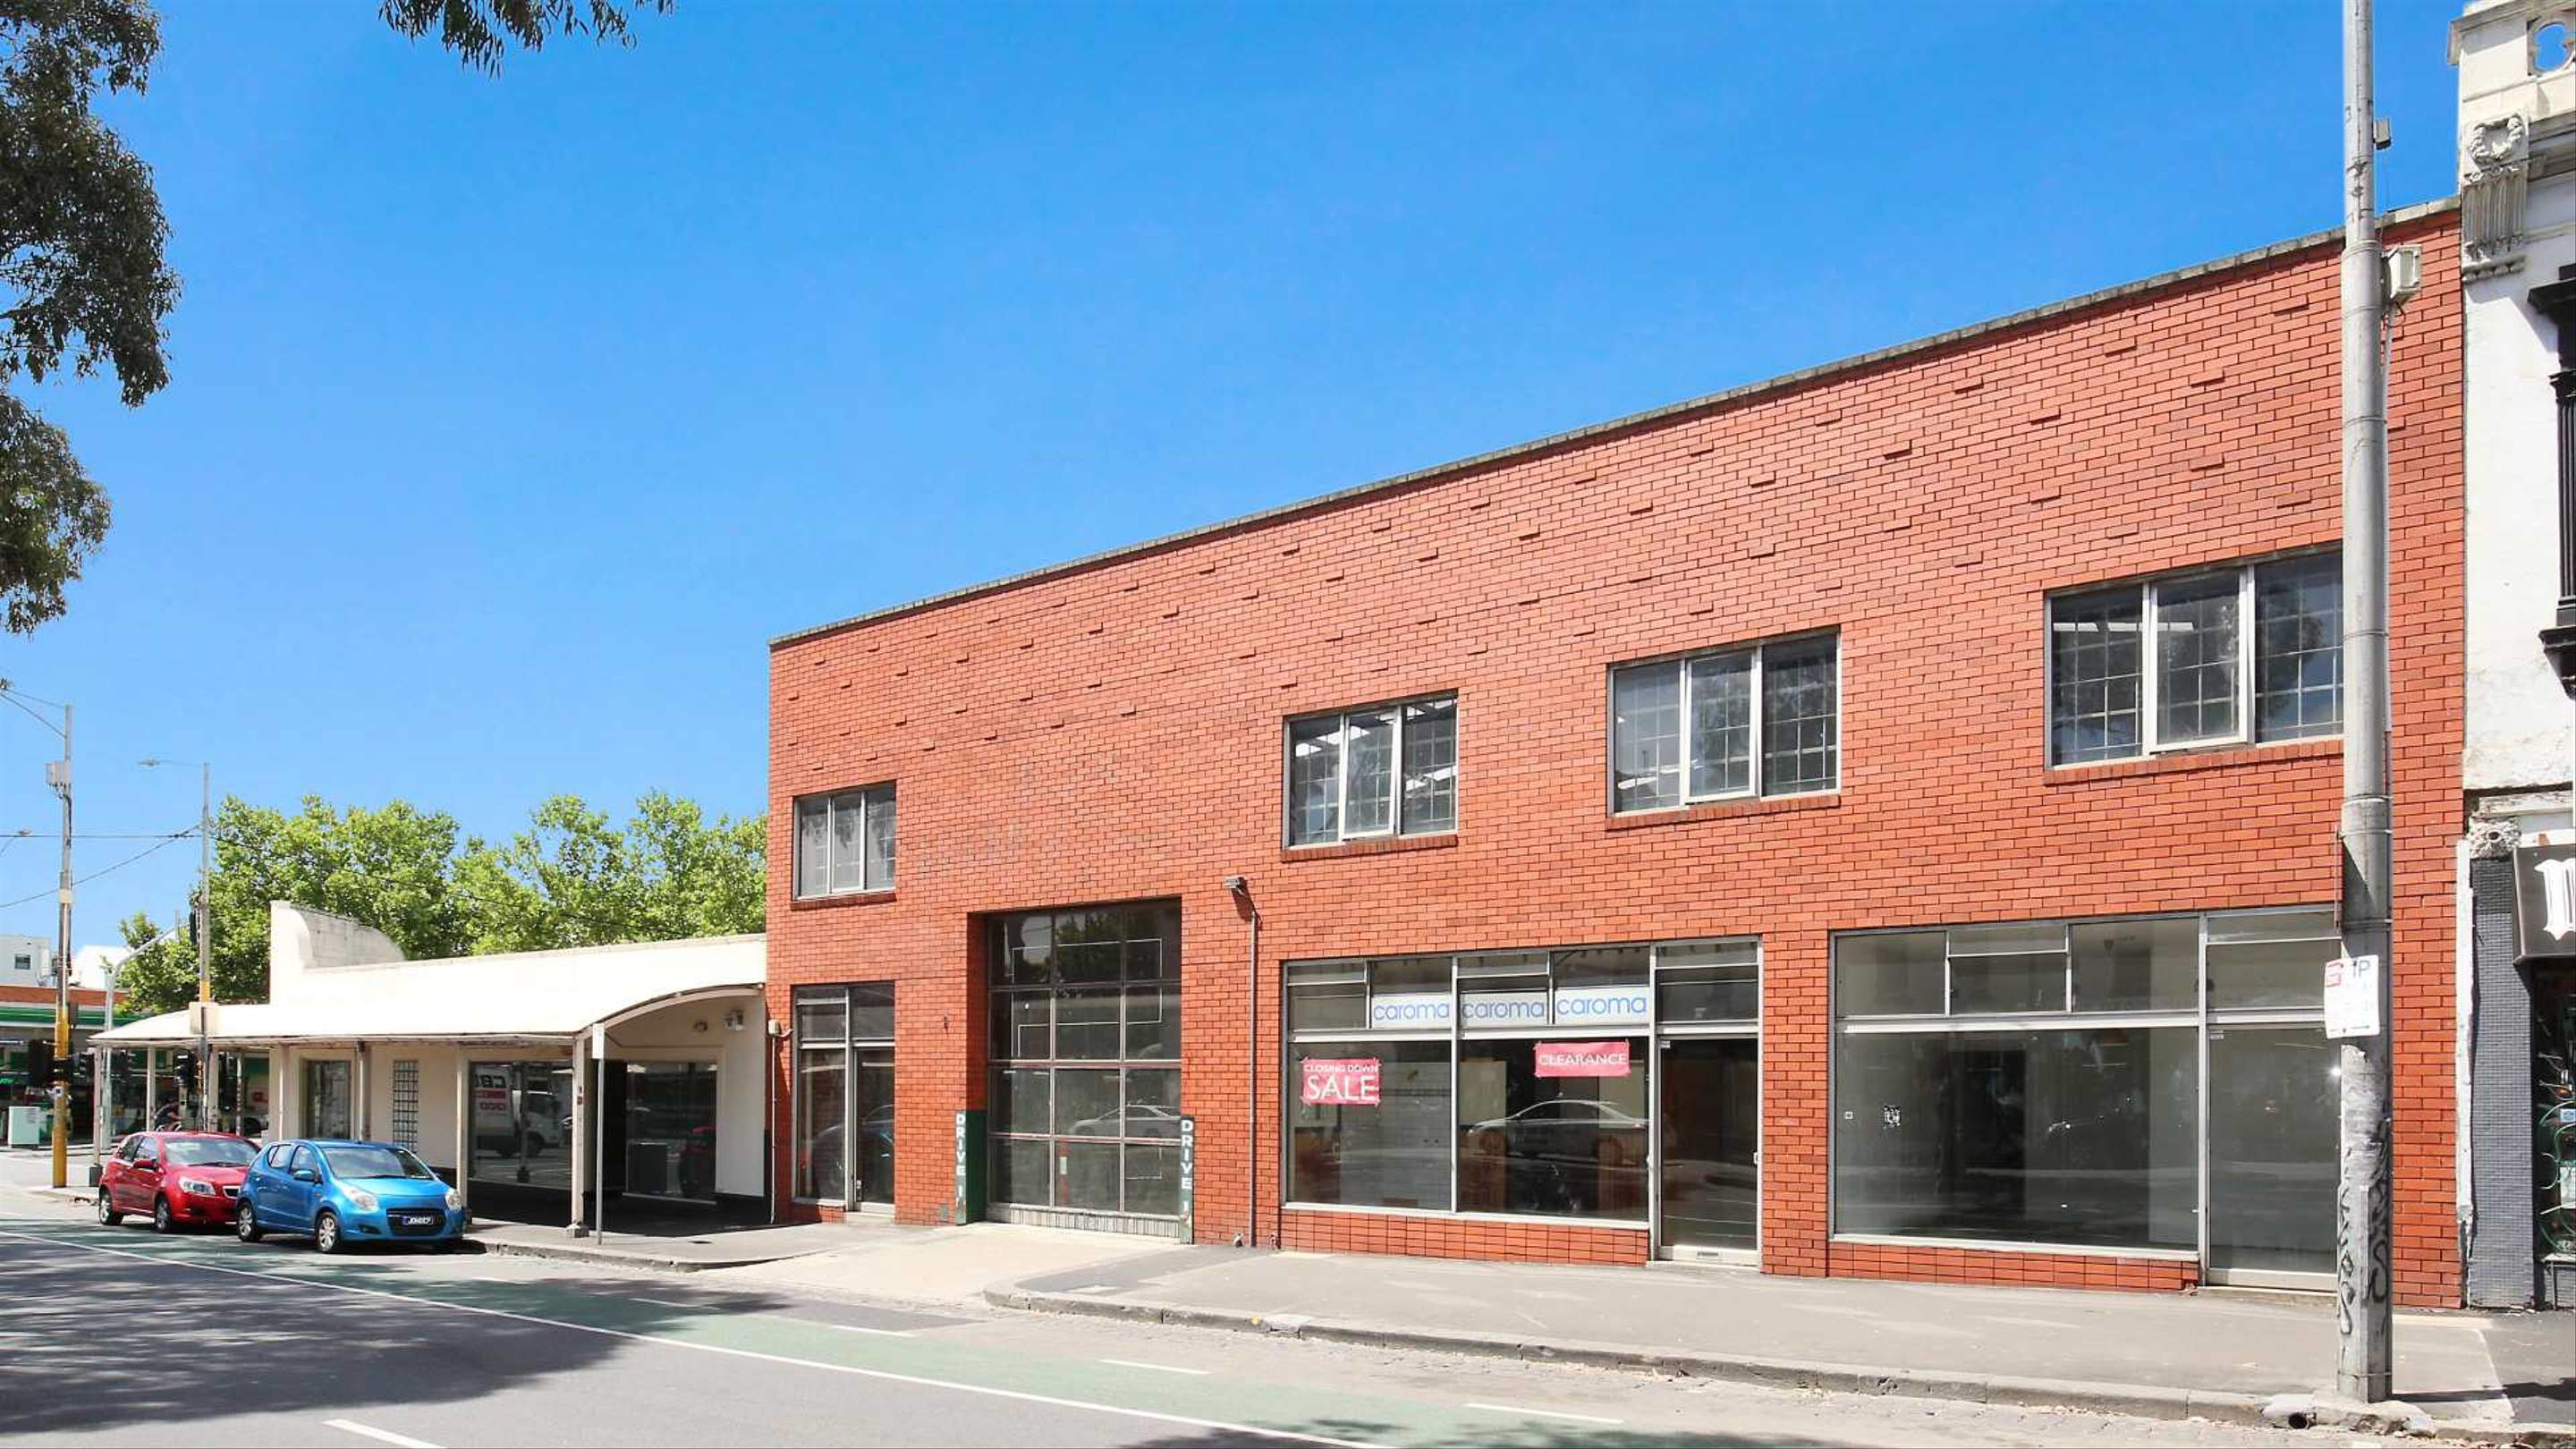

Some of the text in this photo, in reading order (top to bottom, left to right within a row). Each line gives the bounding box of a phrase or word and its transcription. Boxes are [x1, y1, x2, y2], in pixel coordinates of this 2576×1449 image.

[1373, 1002, 1451, 1021] caroma
[1462, 1001, 1546, 1019] caroma
[1555, 996, 1648, 1015] caroma
[1304, 1063, 1378, 1072] CLOSING DOWN
[1538, 1053, 1628, 1066] CLEARANCE
[1307, 1075, 1377, 1101] SALE
[955, 1112, 967, 1177] DRIVE
[1180, 1119, 1194, 1190] DRIVE
